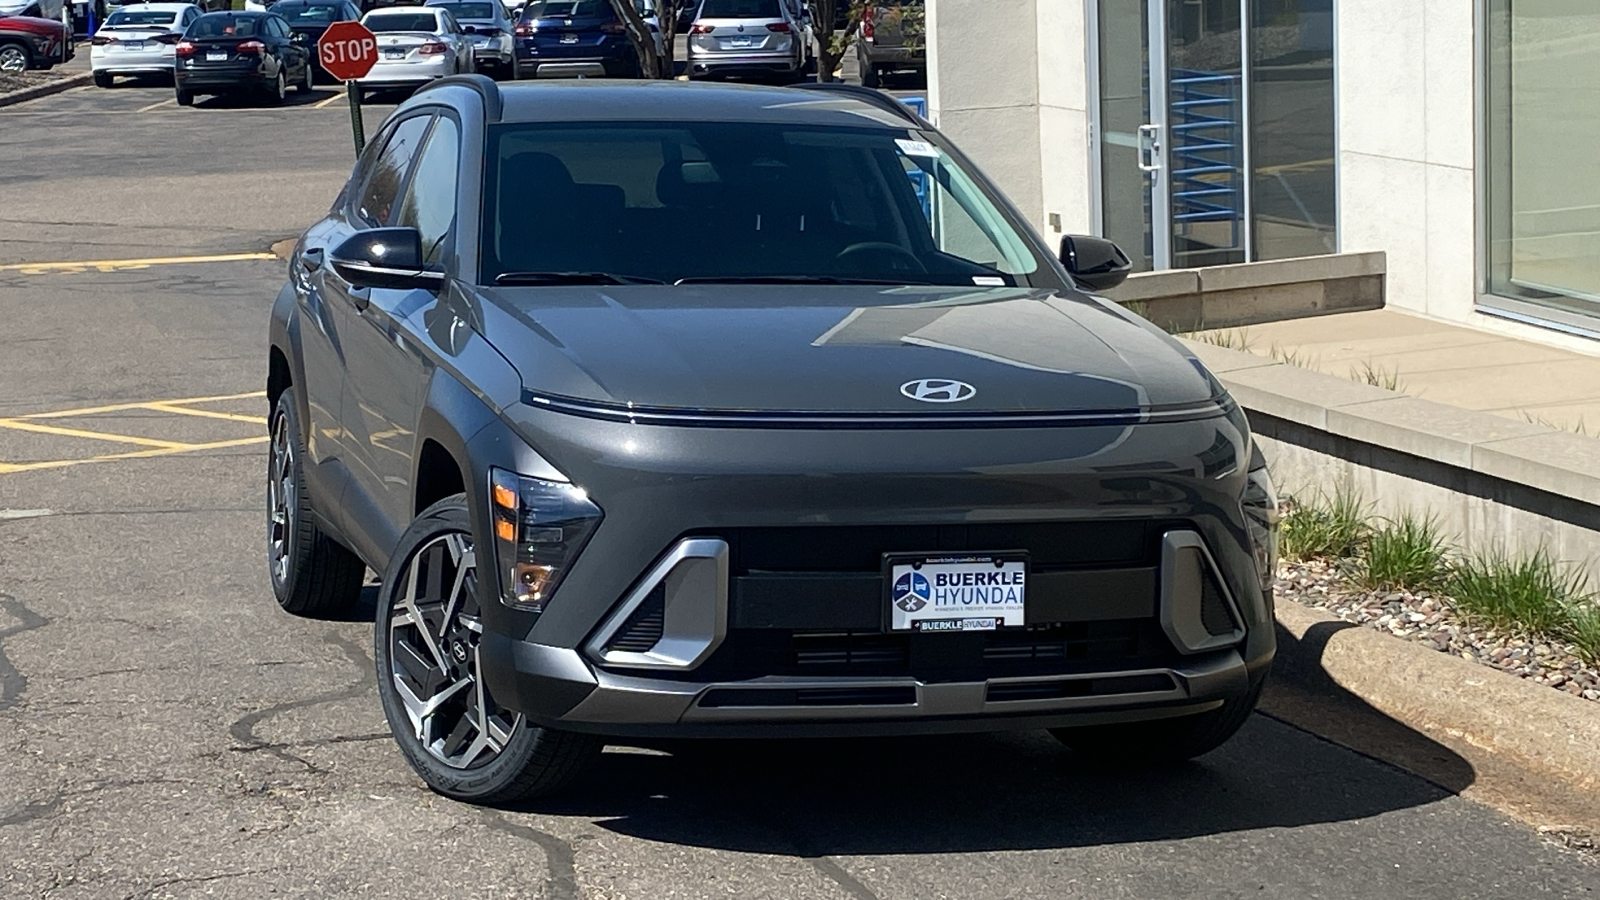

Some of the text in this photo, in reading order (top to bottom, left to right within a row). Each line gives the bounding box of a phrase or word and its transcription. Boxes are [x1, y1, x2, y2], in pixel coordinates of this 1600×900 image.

[323, 38, 374, 64] STOP
[936, 572, 1023, 587] BUERKLE
[935, 587, 1023, 606] HYUNDAI
[922, 620, 994, 630] BUERKLE HYUNDAI
